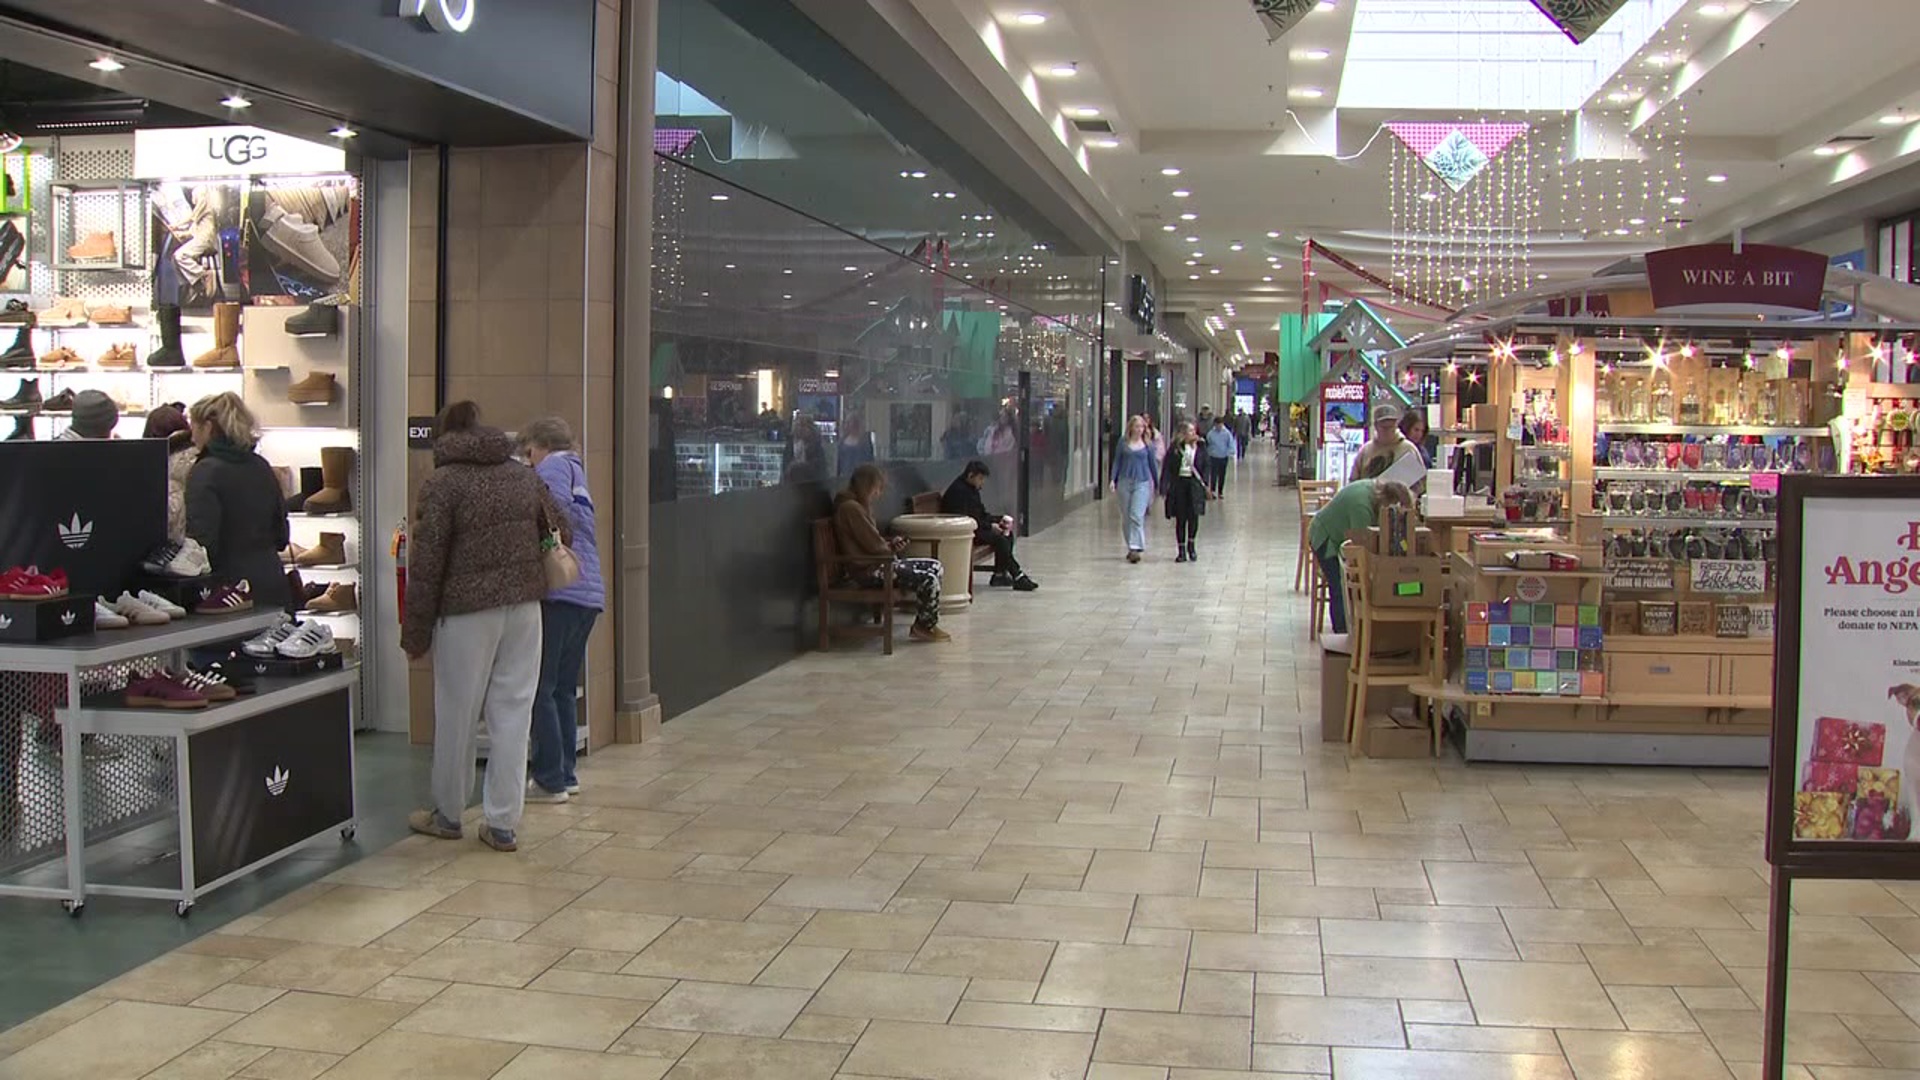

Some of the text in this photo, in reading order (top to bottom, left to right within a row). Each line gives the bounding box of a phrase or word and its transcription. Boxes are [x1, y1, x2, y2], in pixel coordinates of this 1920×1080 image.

[209, 134, 267, 165] UGG
[1682, 269, 1794, 286] WINE A BIT
[1824, 608, 1859, 617] Please
[1860, 607, 1898, 617] choose
[1899, 609, 1915, 617] an
[1838, 620, 1919, 630] donate to NEPA
